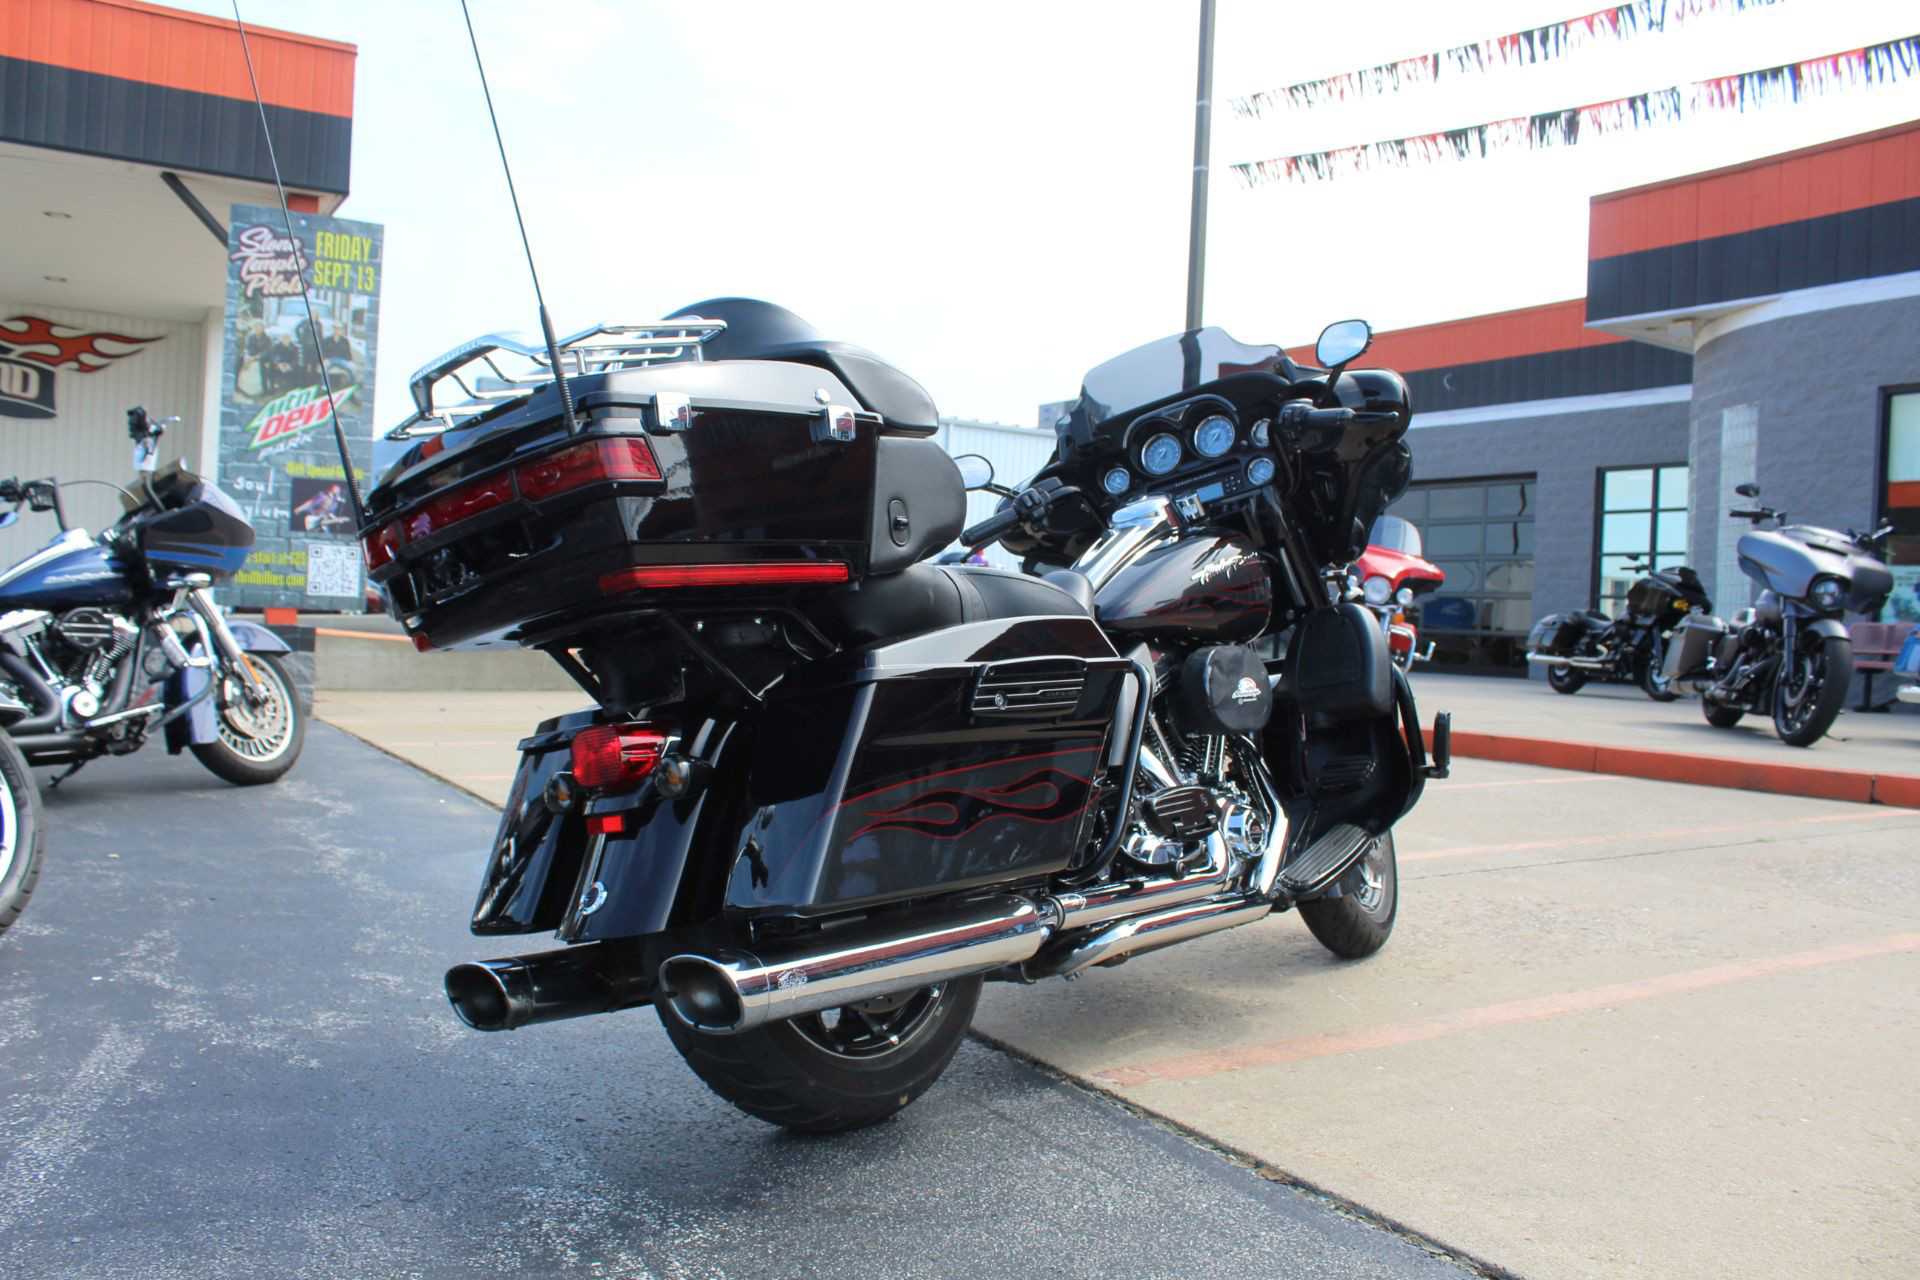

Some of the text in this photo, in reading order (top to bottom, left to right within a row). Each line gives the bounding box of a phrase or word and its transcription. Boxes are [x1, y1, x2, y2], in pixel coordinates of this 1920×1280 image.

[240, 226, 302, 252] Stone
[315, 231, 371, 263] FRIDAY
[231, 251, 307, 281] Temple
[314, 260, 375, 292] SEPT 13
[246, 273, 308, 298] Pilots
[233, 467, 273, 495] Soul
